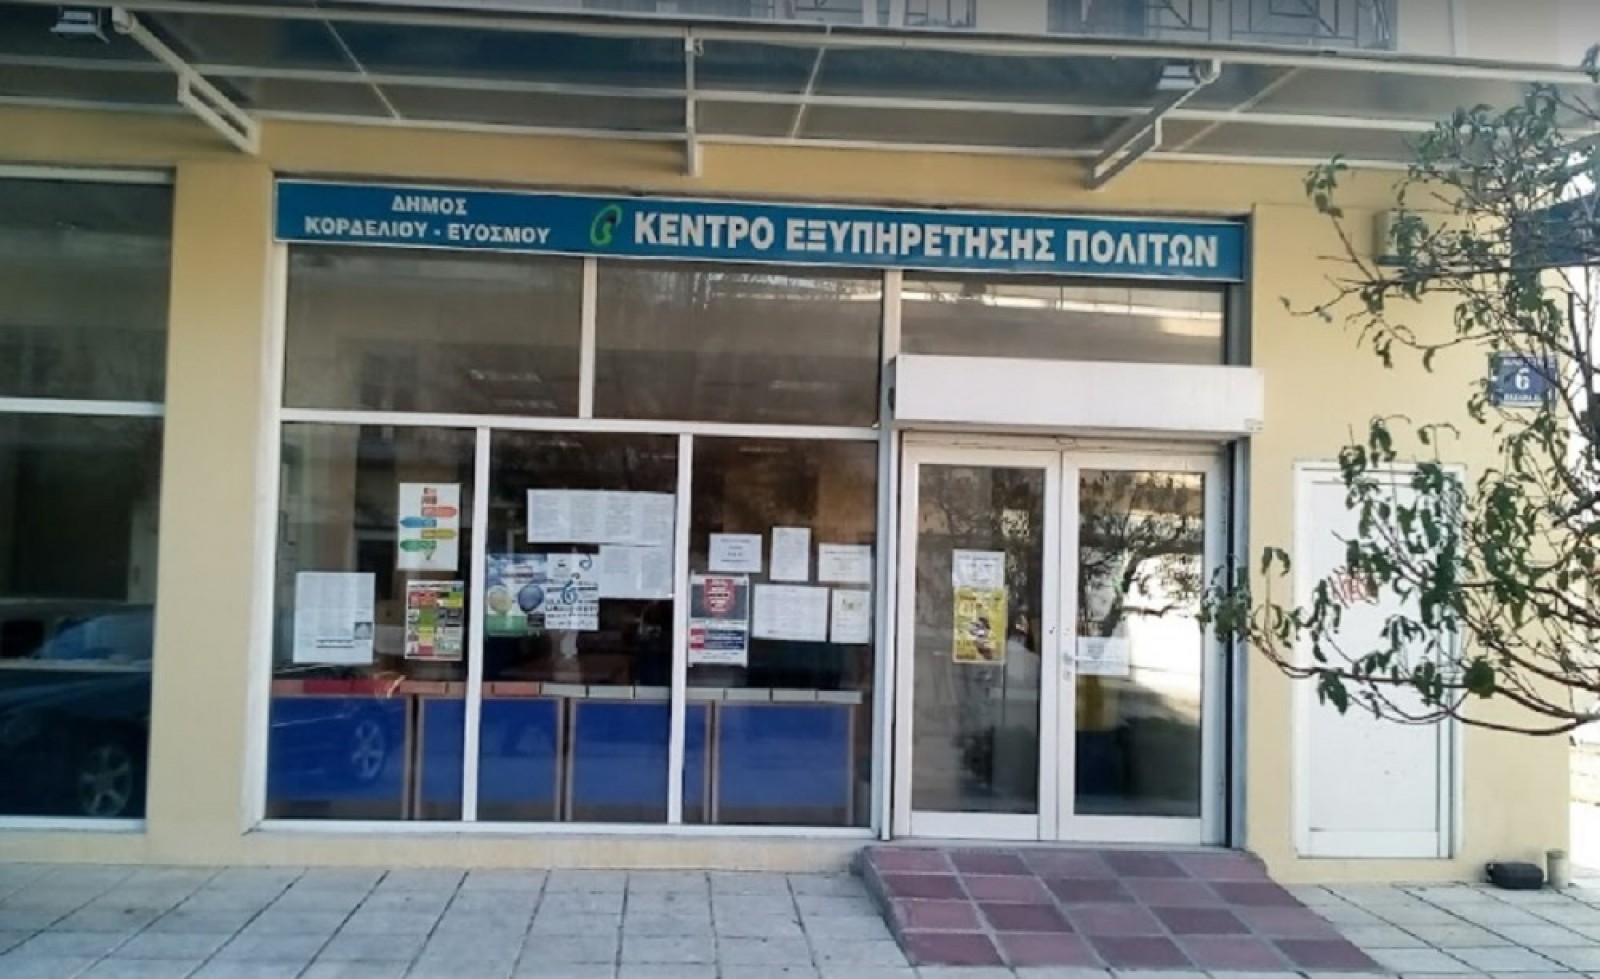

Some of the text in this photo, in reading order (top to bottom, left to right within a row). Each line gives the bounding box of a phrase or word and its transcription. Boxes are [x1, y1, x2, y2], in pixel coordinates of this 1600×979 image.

[391, 195, 467, 215] ΔΗΜΟΣ
[305, 216, 427, 238] ΚΟΡΔΕΛΙΟΥ
[448, 223, 550, 244] ΕΥΟΣΜΟΥ
[635, 212, 1218, 266] ΚΕΝΤΡΟ ΕΞΥΠΗΡΕΤΗΣΗΣ ΠΟΛΙΤΩΝ
[1515, 367, 1530, 390] 6
